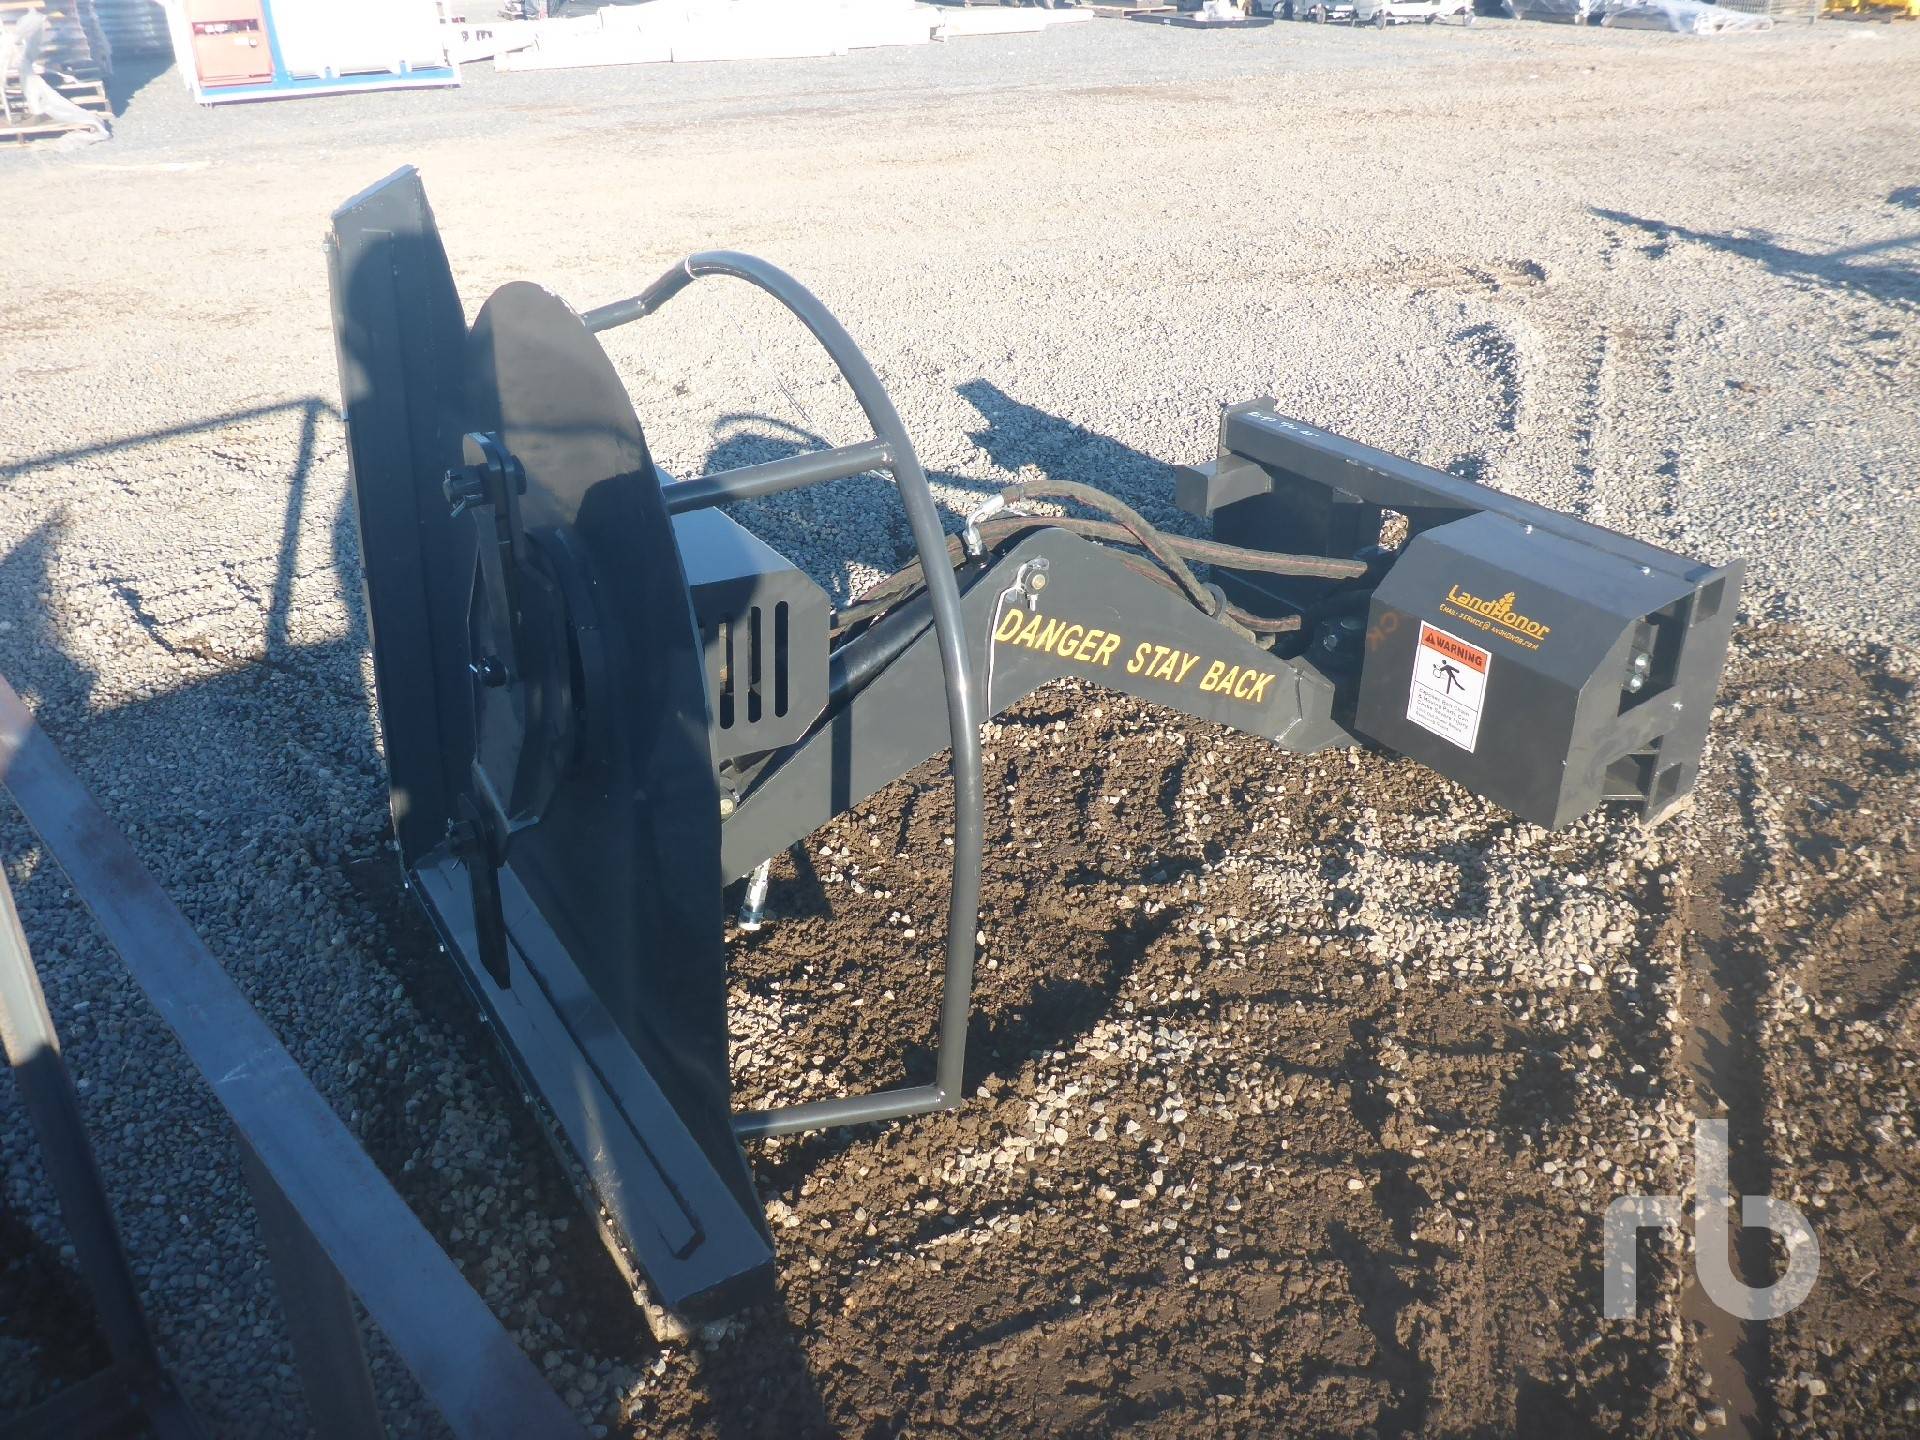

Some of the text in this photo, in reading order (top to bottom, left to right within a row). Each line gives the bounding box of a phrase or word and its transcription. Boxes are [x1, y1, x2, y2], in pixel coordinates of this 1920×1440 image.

[994, 608, 1276, 702] DANGER STAY BACK
[1436, 636, 1483, 667] WARNING
